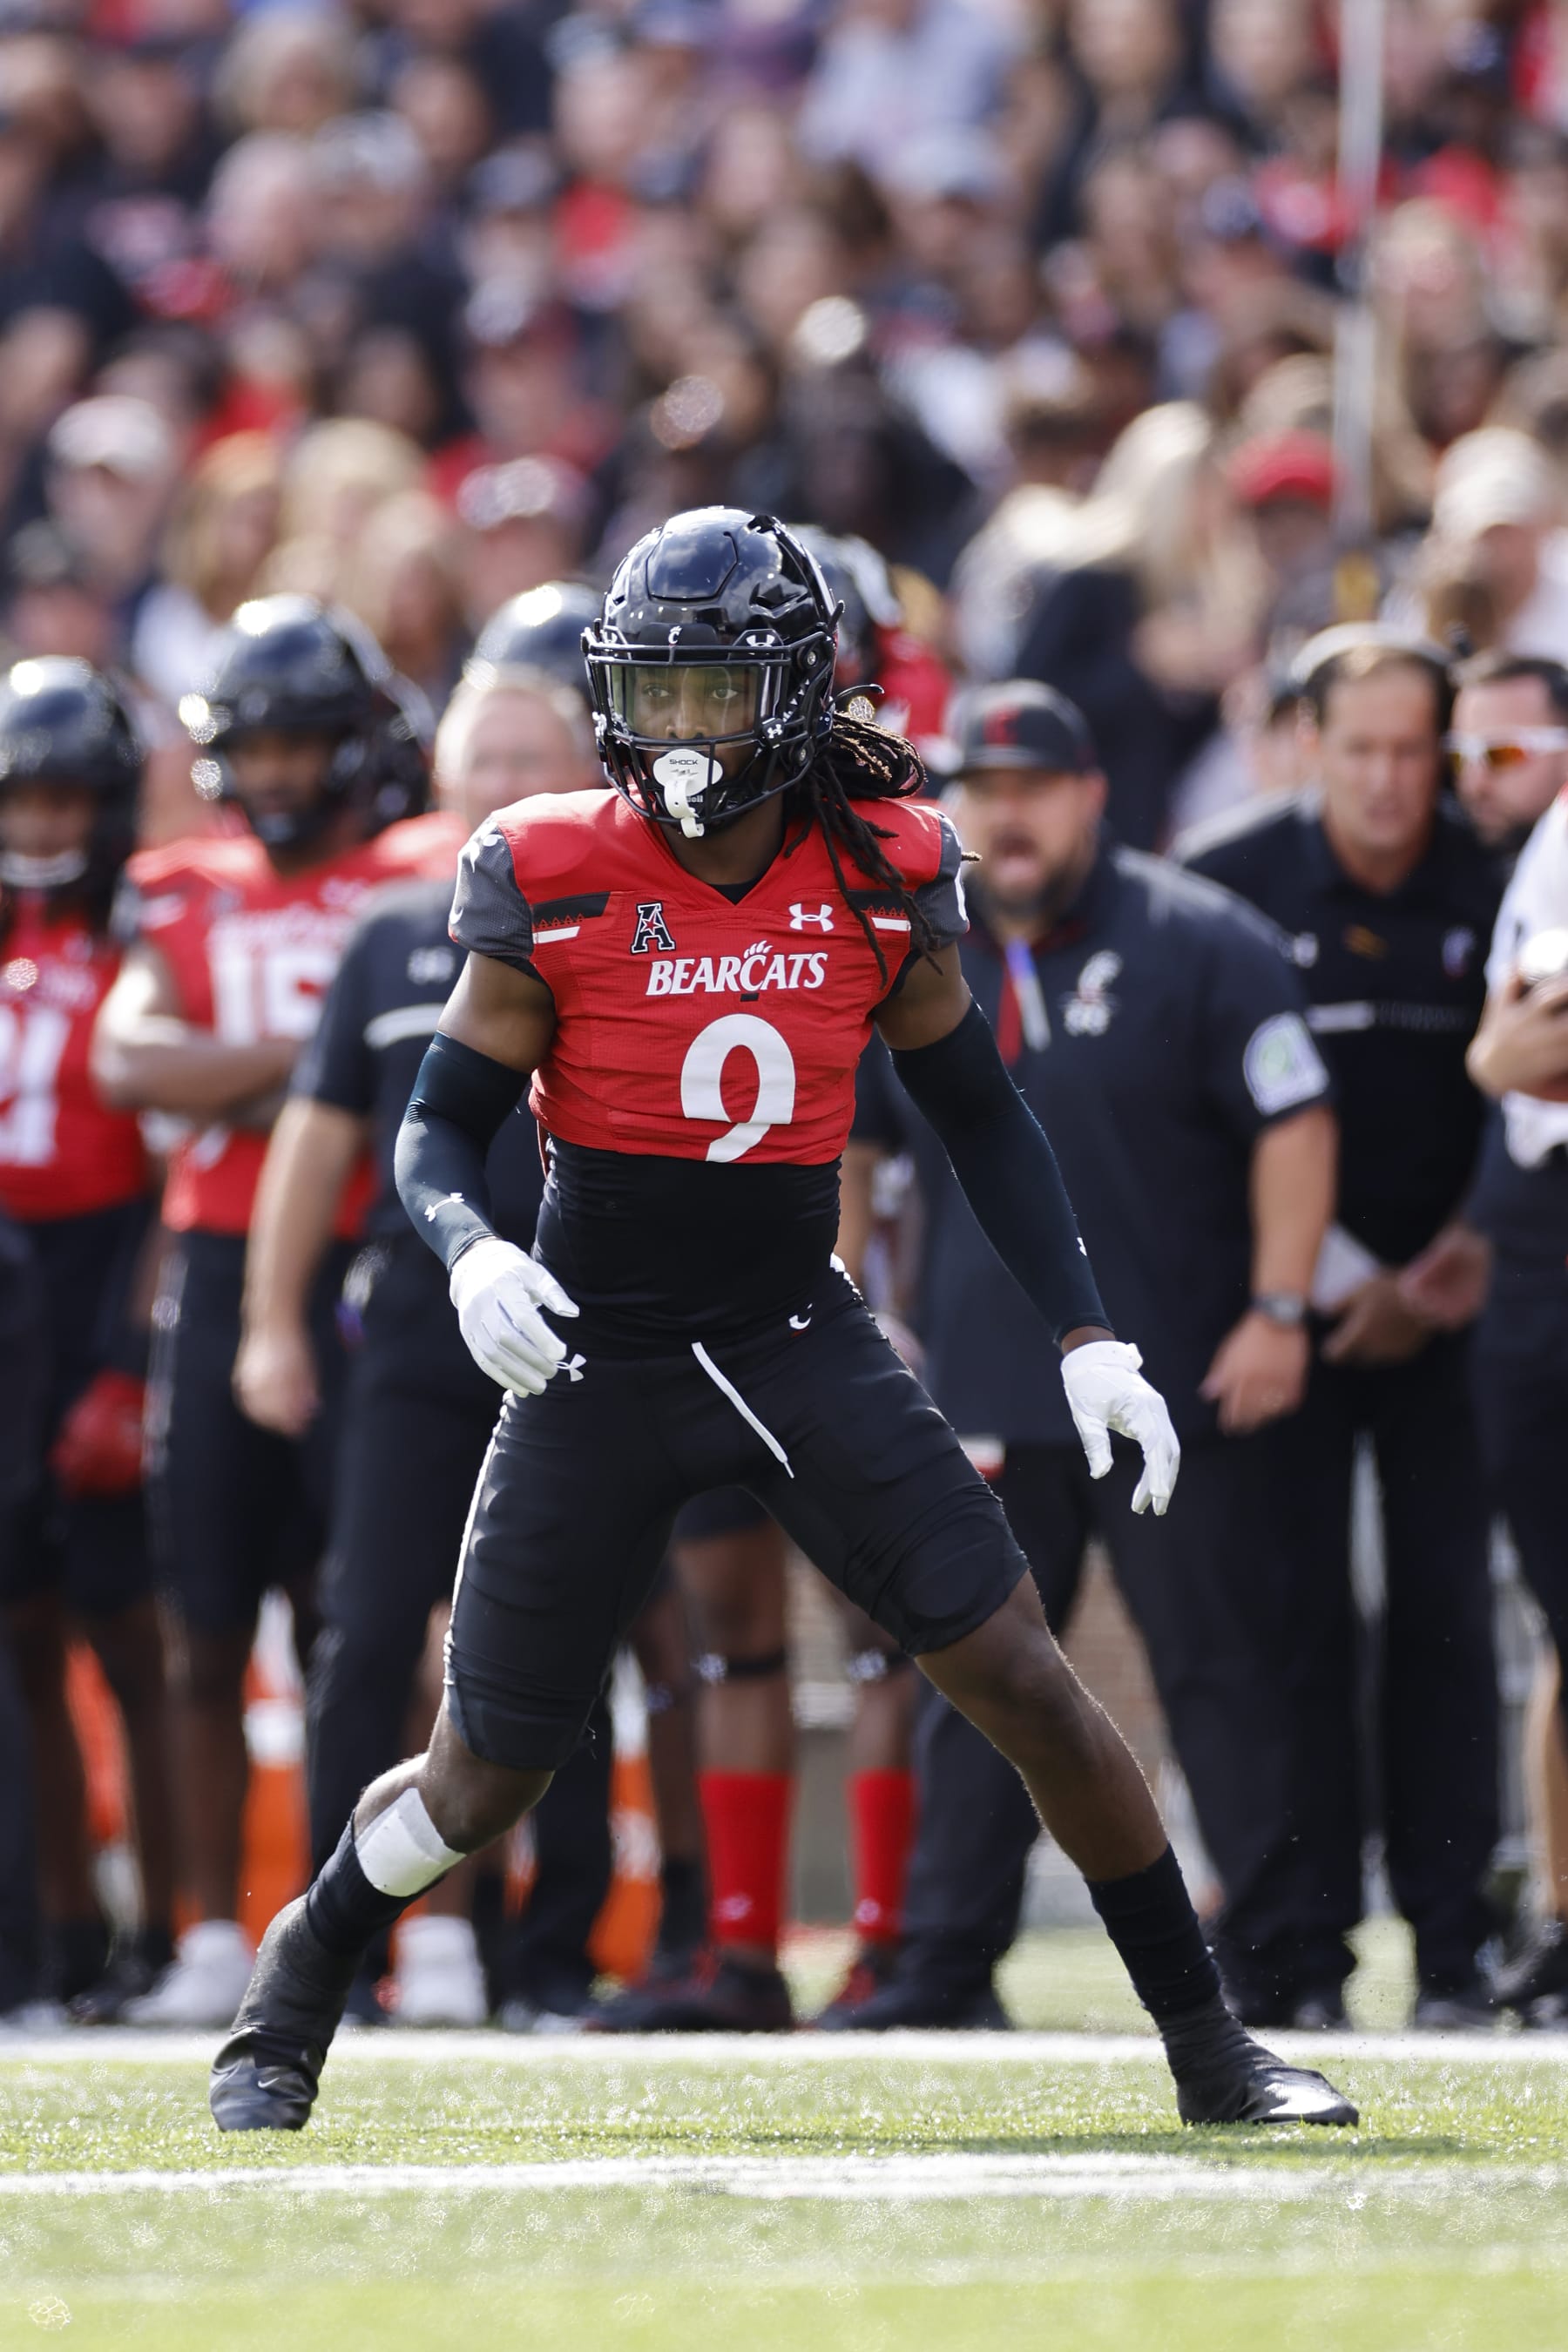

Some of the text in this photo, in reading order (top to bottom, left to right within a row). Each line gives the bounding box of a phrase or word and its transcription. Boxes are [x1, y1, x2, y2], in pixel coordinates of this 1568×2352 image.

[631, 902, 676, 954] A
[645, 940, 828, 995] BEARCATS
[680, 1013, 796, 1163] 9
